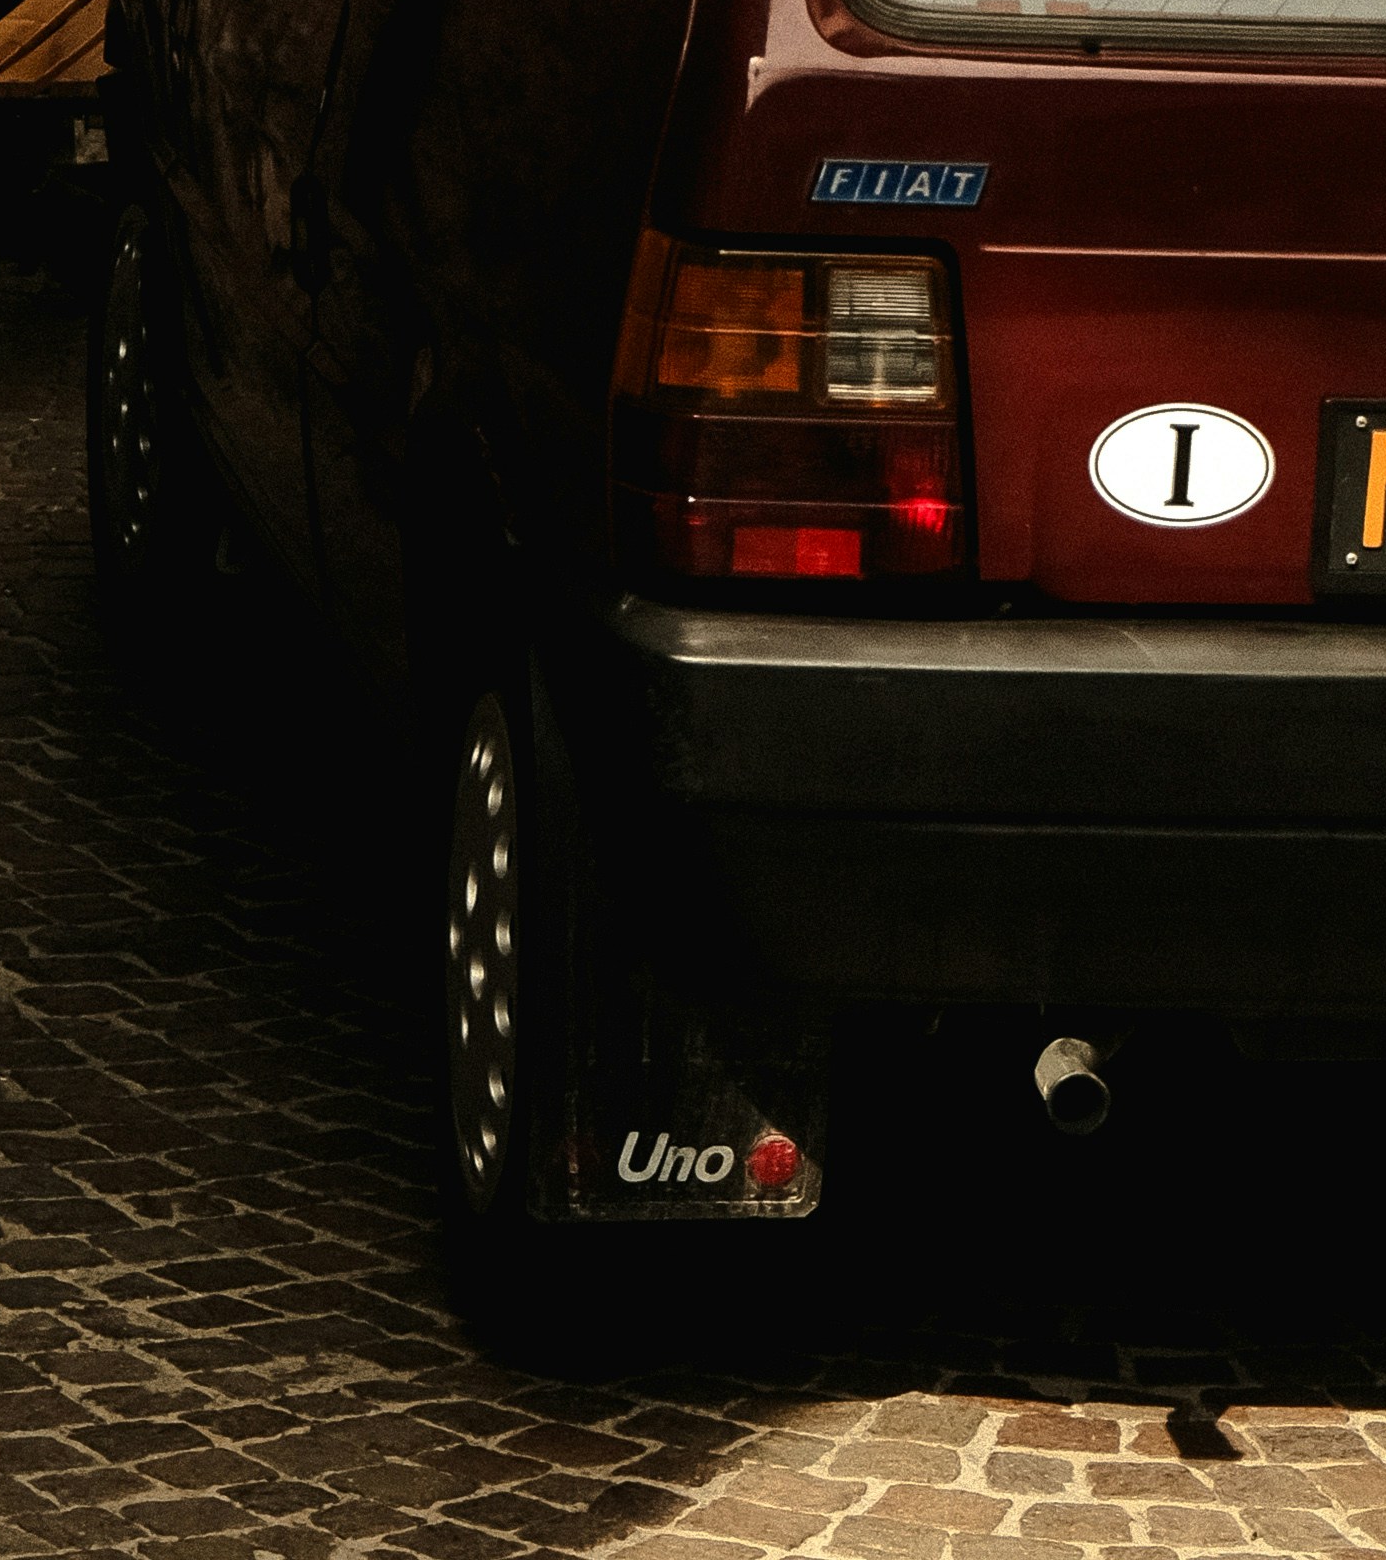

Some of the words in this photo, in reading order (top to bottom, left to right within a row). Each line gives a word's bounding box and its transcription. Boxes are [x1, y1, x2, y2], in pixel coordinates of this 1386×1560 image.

[829, 168, 974, 198] FIAT
[1164, 423, 1200, 507] I
[617, 1131, 735, 1183] Uno
